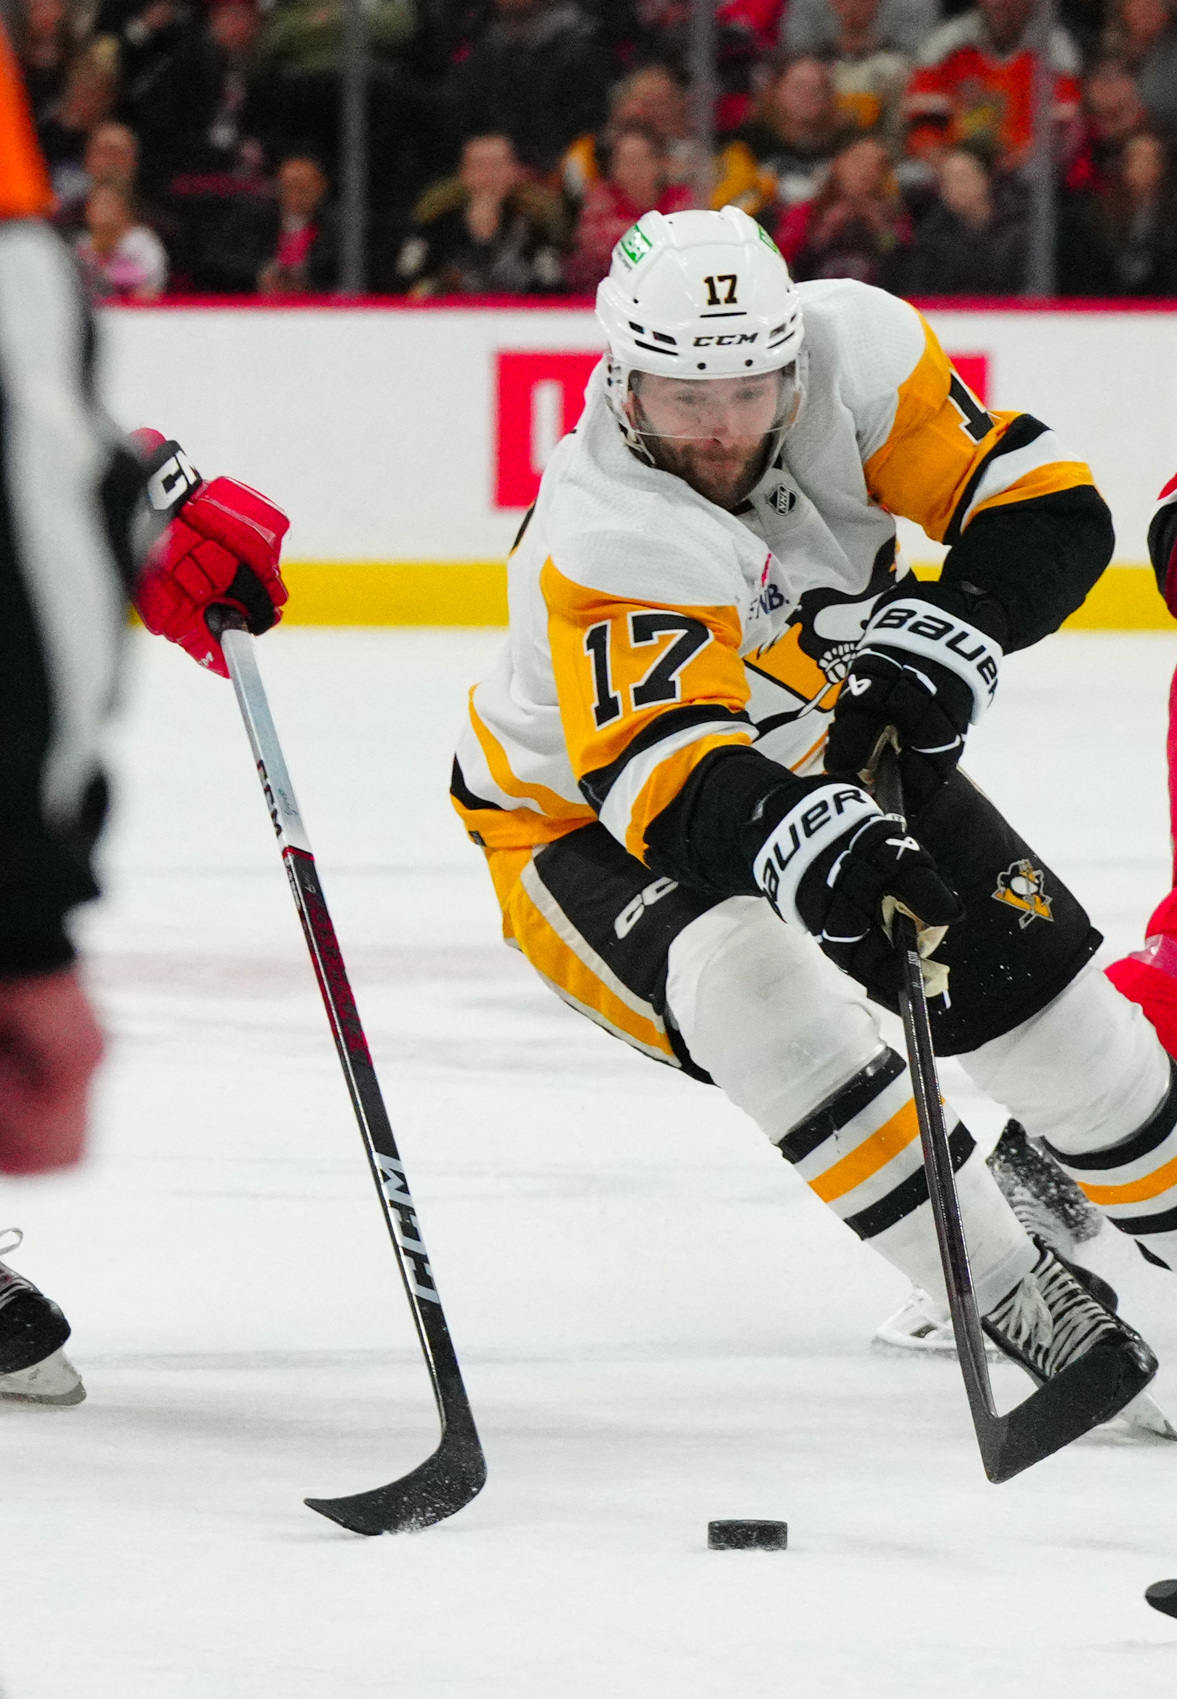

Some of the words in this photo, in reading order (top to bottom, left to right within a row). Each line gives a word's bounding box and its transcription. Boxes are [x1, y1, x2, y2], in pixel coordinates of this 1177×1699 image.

[692, 332, 759, 347] CCM
[704, 274, 738, 306] 17
[948, 366, 995, 446] 1
[582, 608, 715, 733] 17
[763, 789, 867, 924] AUER
[372, 1151, 441, 1305] CCM
